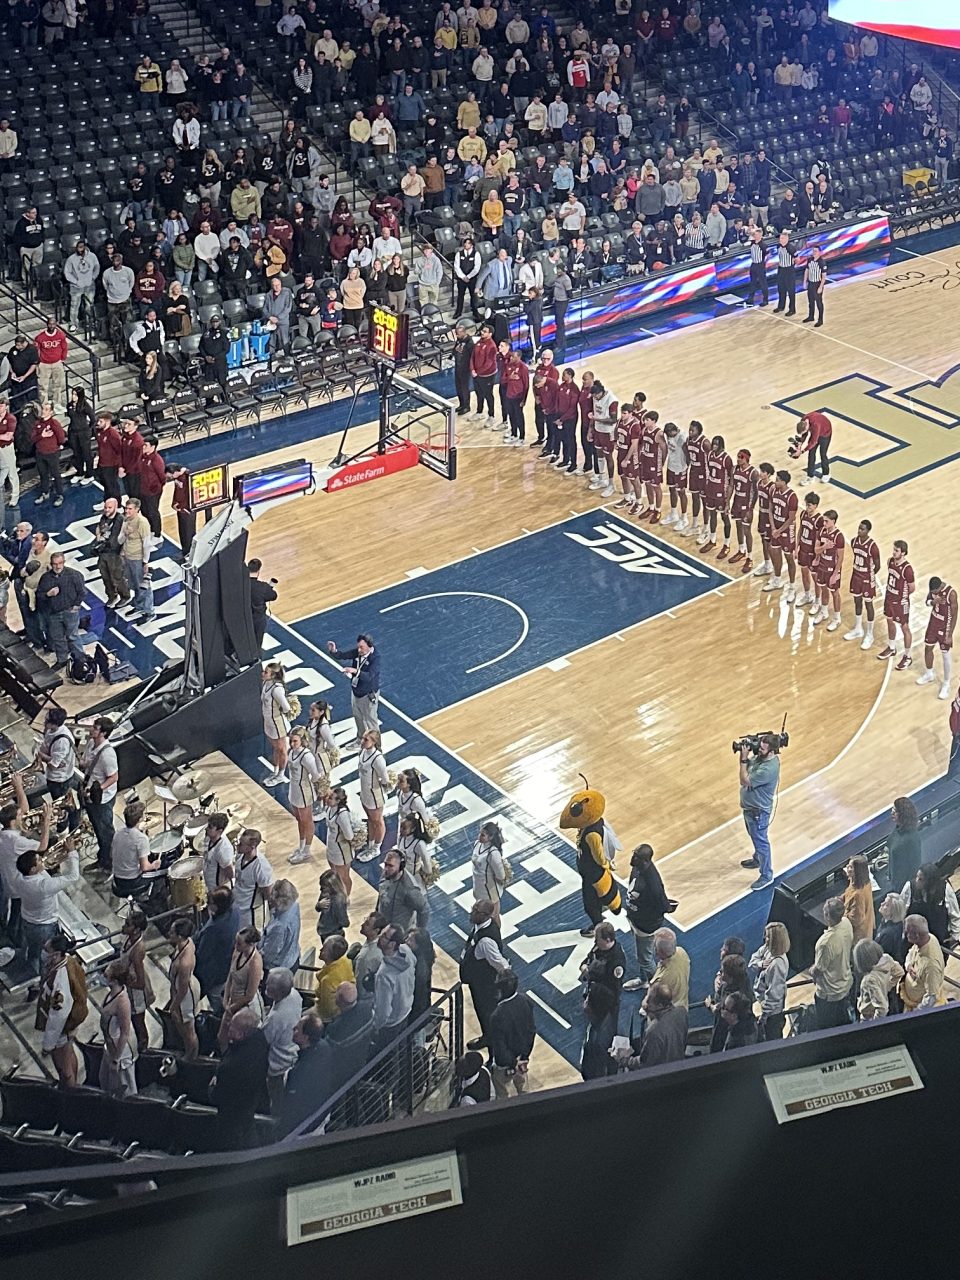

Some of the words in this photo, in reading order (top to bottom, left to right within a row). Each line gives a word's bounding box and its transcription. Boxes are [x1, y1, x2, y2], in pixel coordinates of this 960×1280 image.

[373, 308, 397, 328] 20:00
[191, 467, 223, 488] 20:00
[198, 484, 219, 501] 30
[563, 525, 692, 577] ACC
[805, 1093, 857, 1110] GEORGIA
[858, 1082, 894, 1098] TECH
[323, 1207, 385, 1231] GEORGIA
[388, 1196, 428, 1216] TECH
